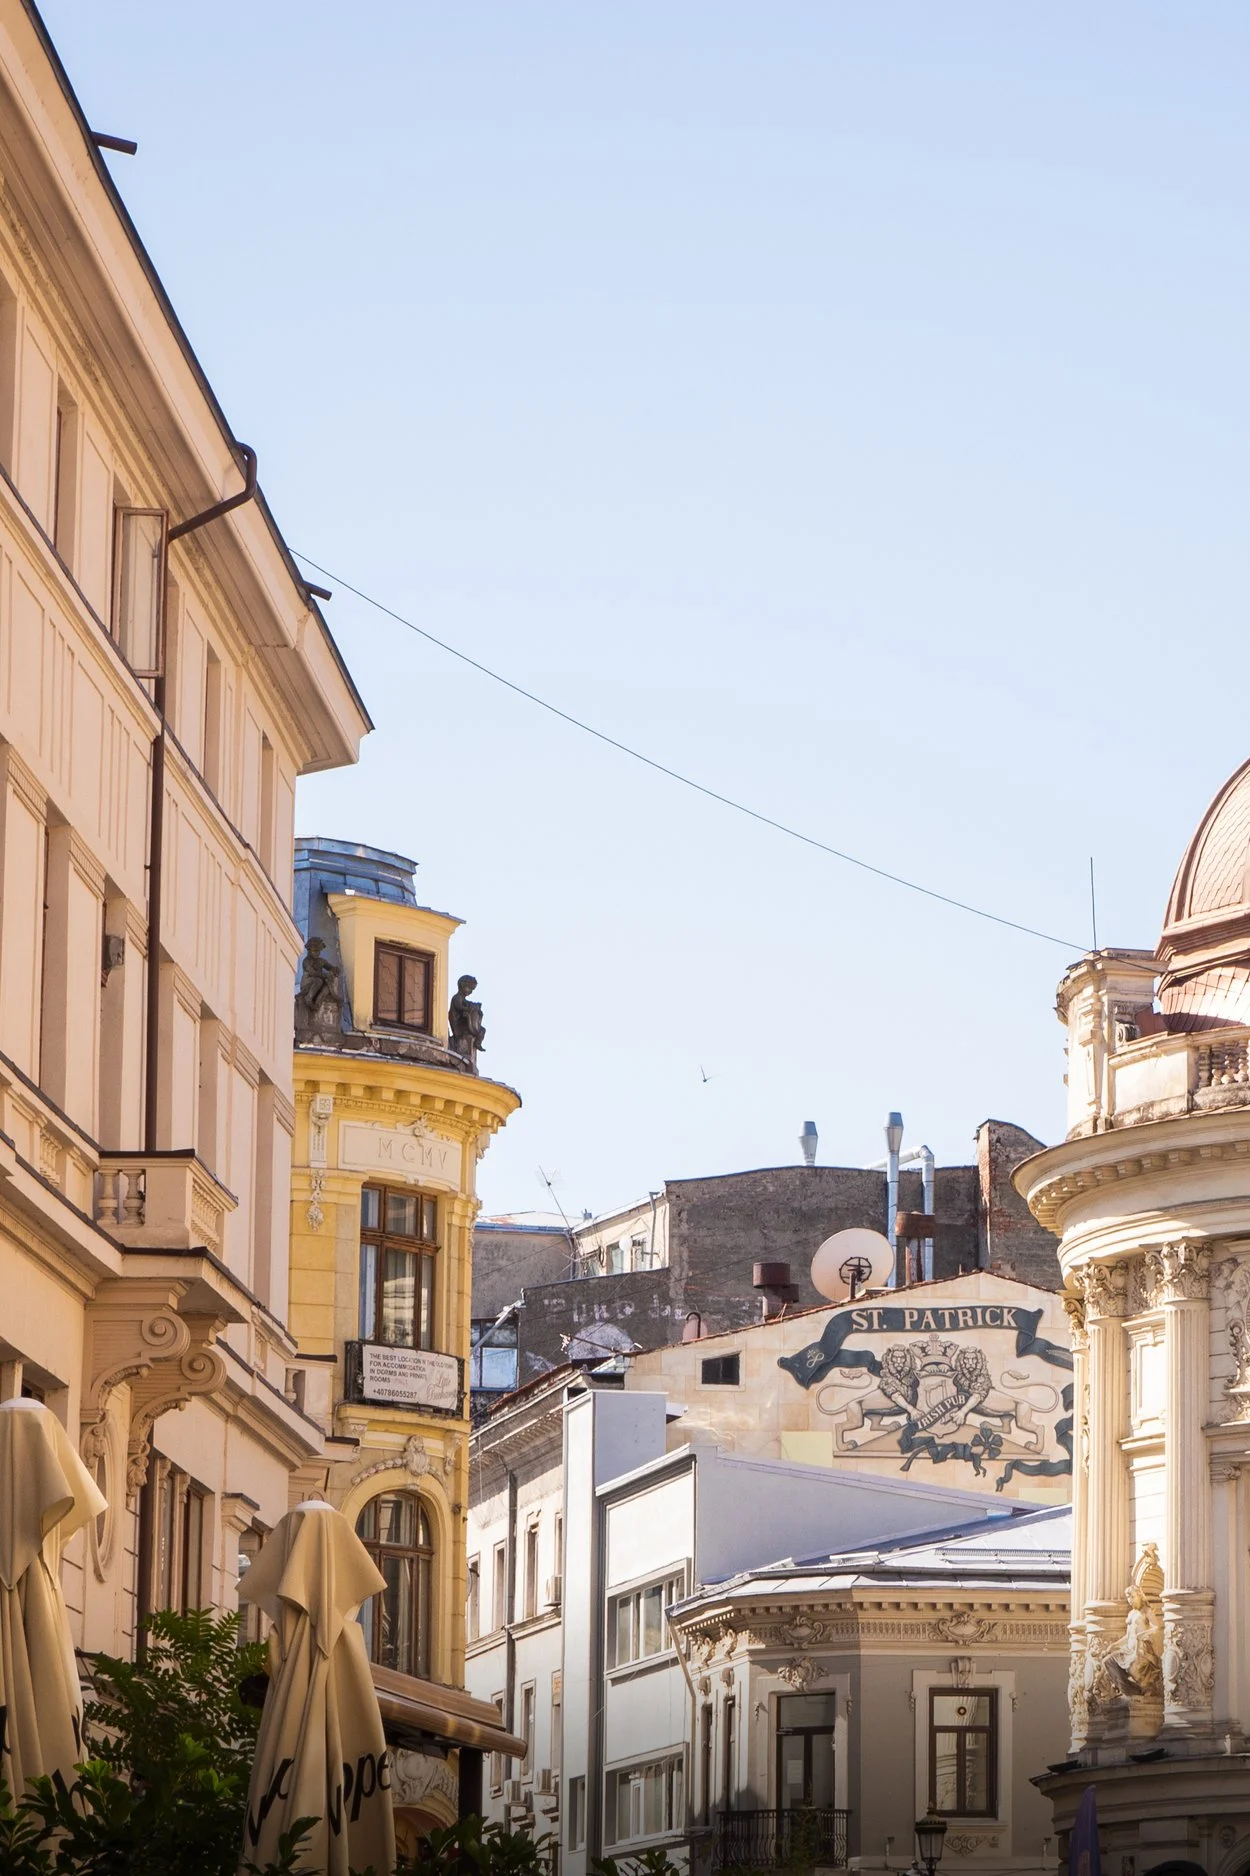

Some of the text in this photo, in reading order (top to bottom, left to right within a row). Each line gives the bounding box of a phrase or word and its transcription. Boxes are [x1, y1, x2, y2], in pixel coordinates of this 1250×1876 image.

[378, 1137, 447, 1170] MCMV
[851, 1307, 1018, 1330] ST. PATRICK
[369, 1353, 381, 1361] THE
[382, 1354, 397, 1363] BEST
[370, 1376, 391, 1384] ROOMS
[377, 1369, 397, 1377] DORMS
[917, 1394, 966, 1430] IRISH PUB
